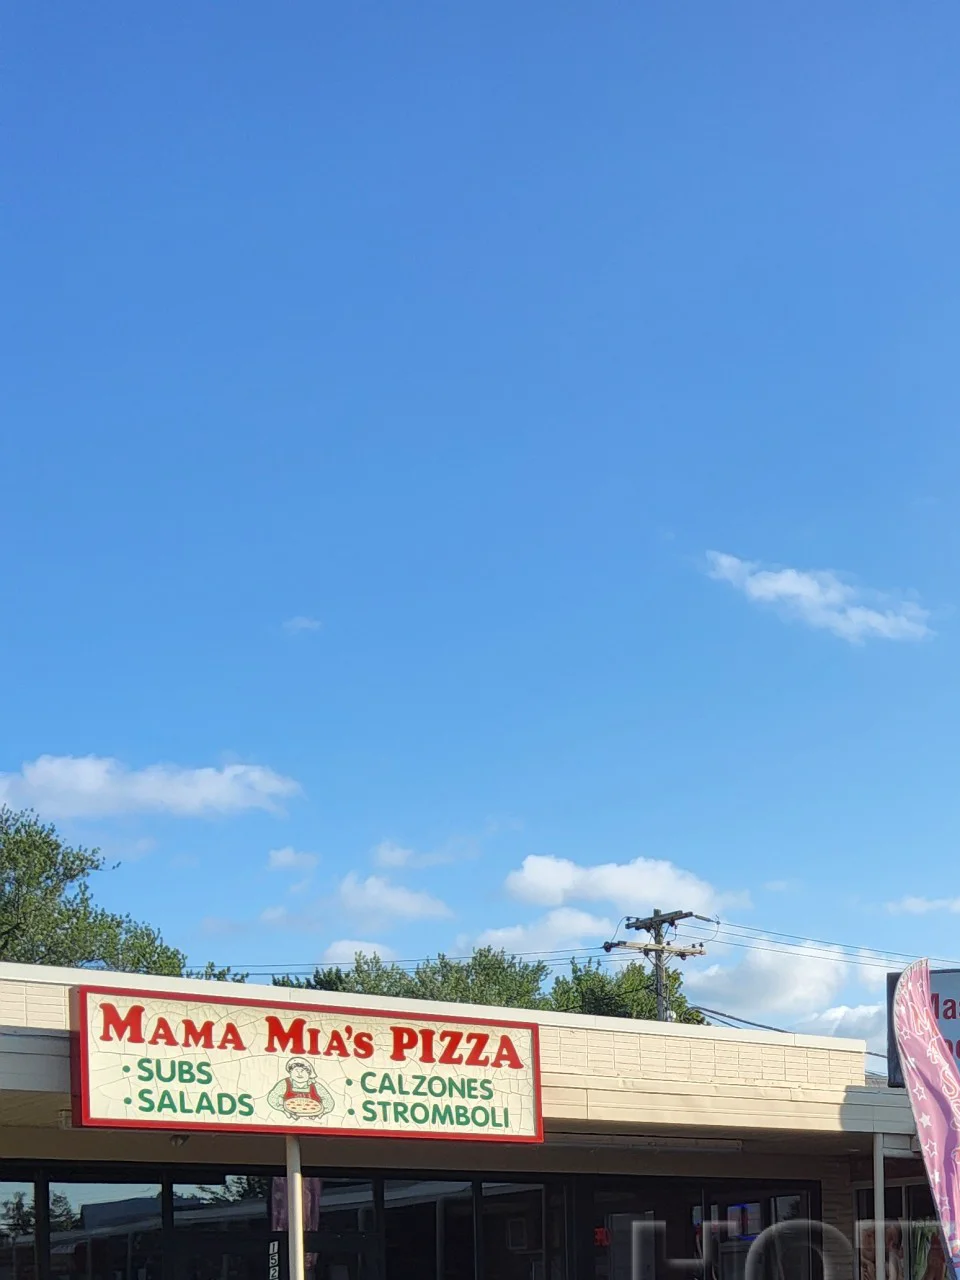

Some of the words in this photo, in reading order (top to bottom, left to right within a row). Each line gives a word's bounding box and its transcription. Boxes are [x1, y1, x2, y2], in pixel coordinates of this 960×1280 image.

[99, 1002, 247, 1051] MAMA
[389, 1025, 525, 1069] PIZZA
[137, 1057, 213, 1085] SUBS
[360, 1071, 494, 1101] CALZONES
[138, 1088, 255, 1117] SALADS
[362, 1100, 510, 1128] STROMBOLI
